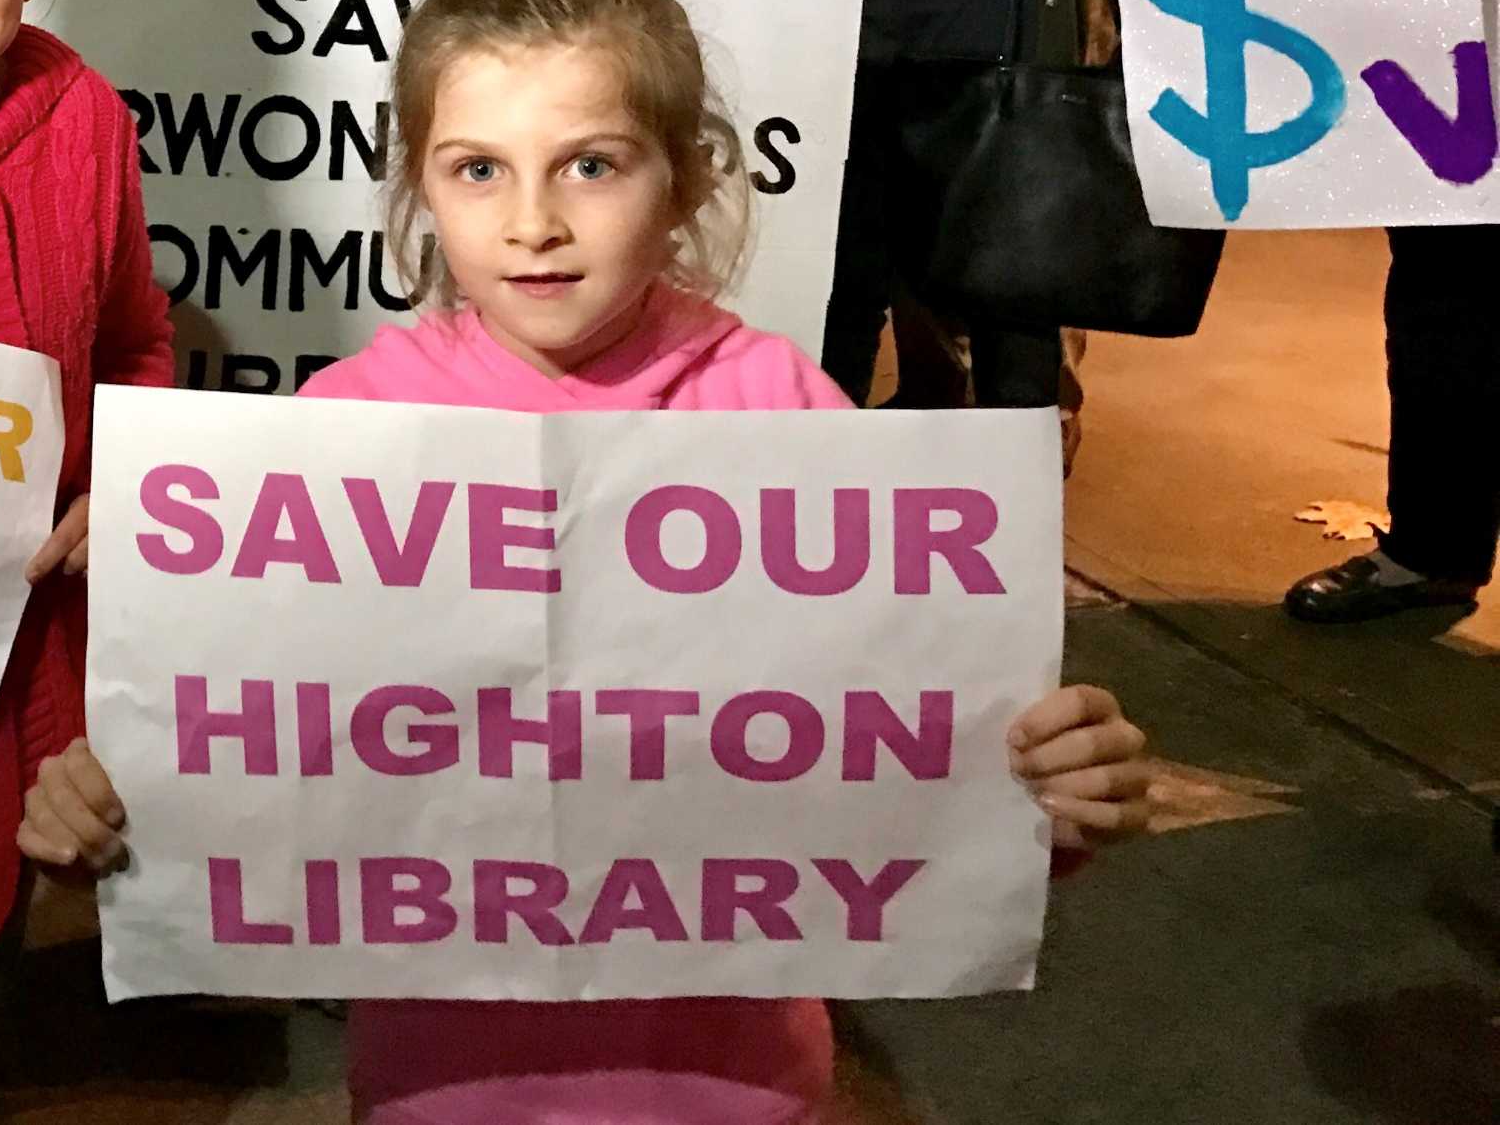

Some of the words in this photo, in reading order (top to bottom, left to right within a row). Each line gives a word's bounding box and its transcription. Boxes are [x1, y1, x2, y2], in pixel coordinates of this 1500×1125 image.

[134, 463, 562, 593] SAVE
[623, 484, 1008, 597] OUR
[174, 674, 955, 784] HIGHTON
[207, 855, 928, 948] LIBRARY
